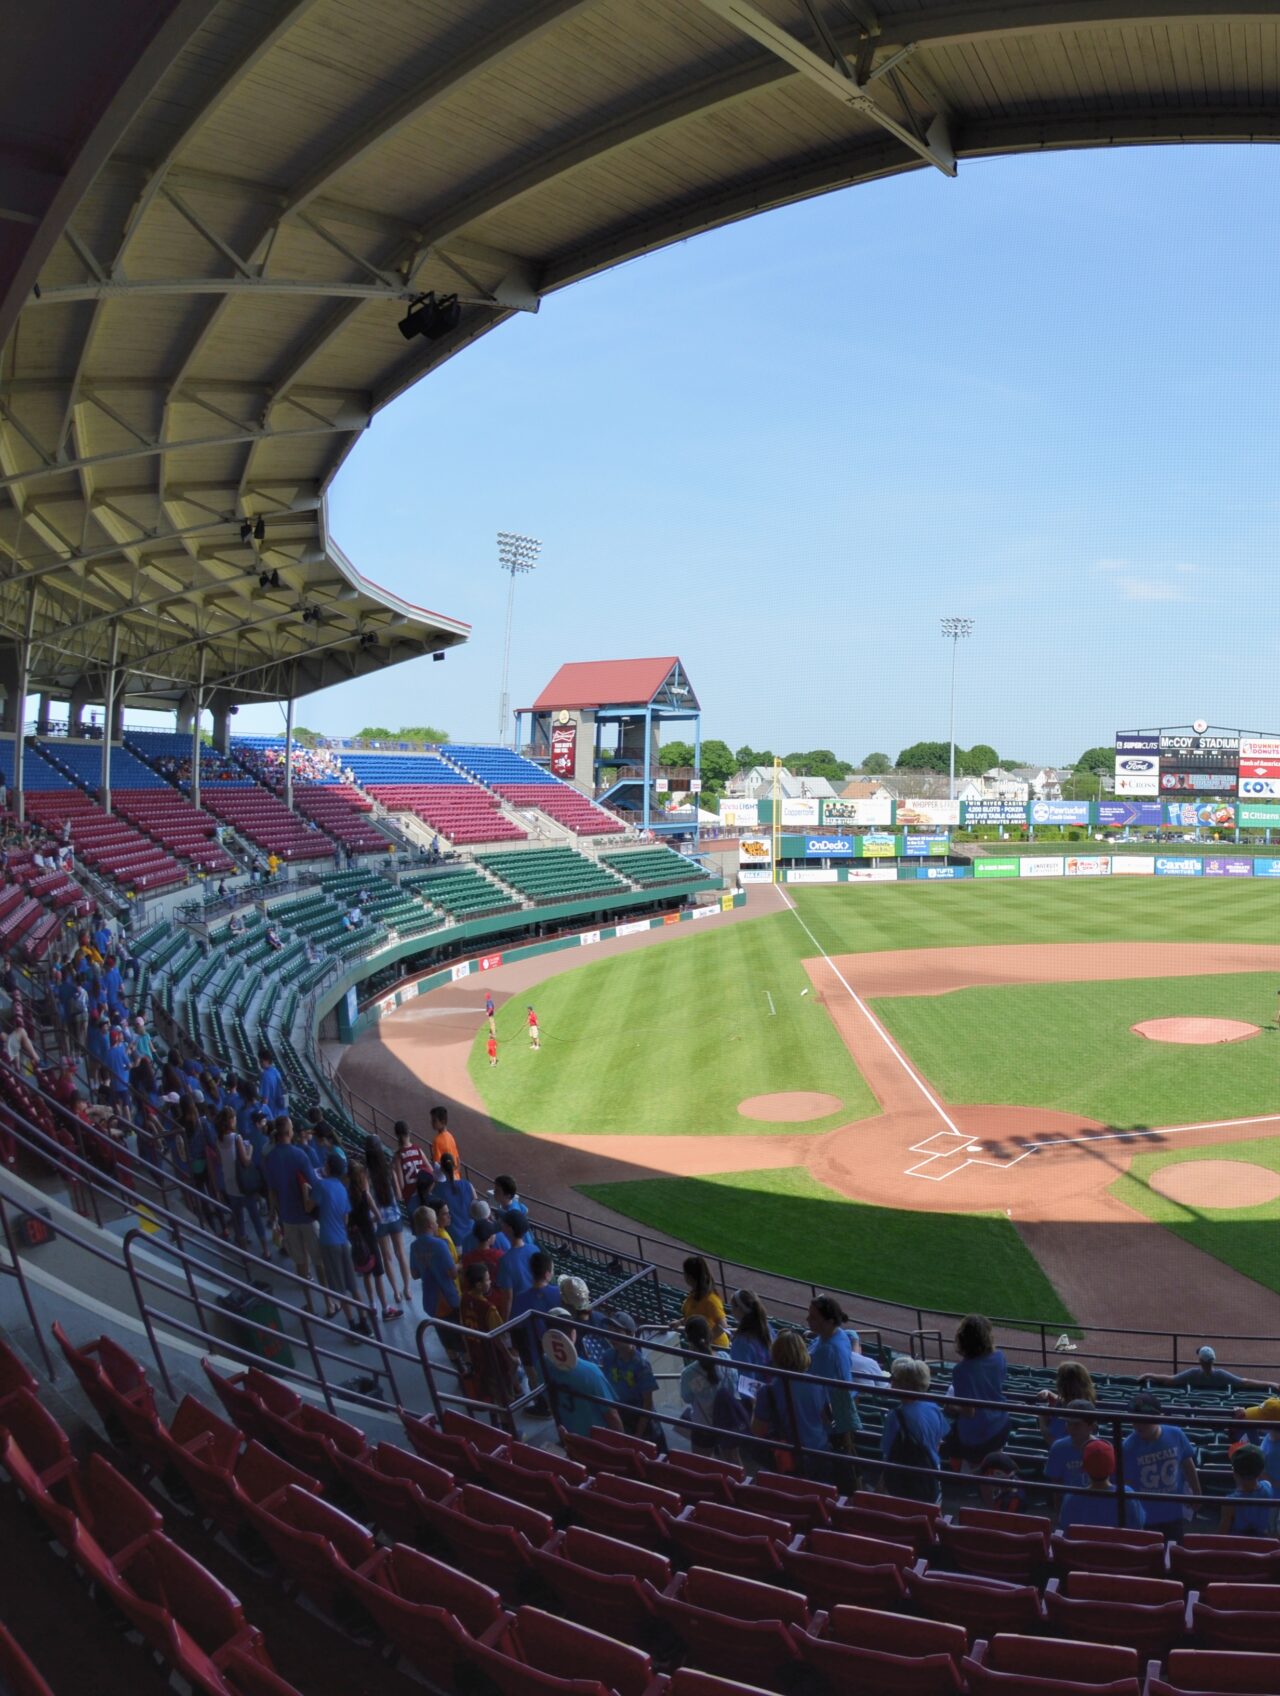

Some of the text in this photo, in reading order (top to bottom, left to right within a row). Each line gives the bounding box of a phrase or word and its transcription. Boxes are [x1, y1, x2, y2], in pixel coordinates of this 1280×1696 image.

[1161, 738, 1238, 748] McCOY STADIUM
[1125, 760, 1150, 770] Ford
[1242, 782, 1275, 794] COX
[912, 800, 938, 808] WHOPPER
[784, 806, 814, 816] Coppertone
[1050, 806, 1086, 814] Pawtucket
[1249, 812, 1279, 820] Citizens
[808, 841, 842, 850] OnDeck
[1156, 860, 1202, 870] Cardi's
[551, 1340, 567, 1362] 5
[1140, 1459, 1178, 1488] GO
